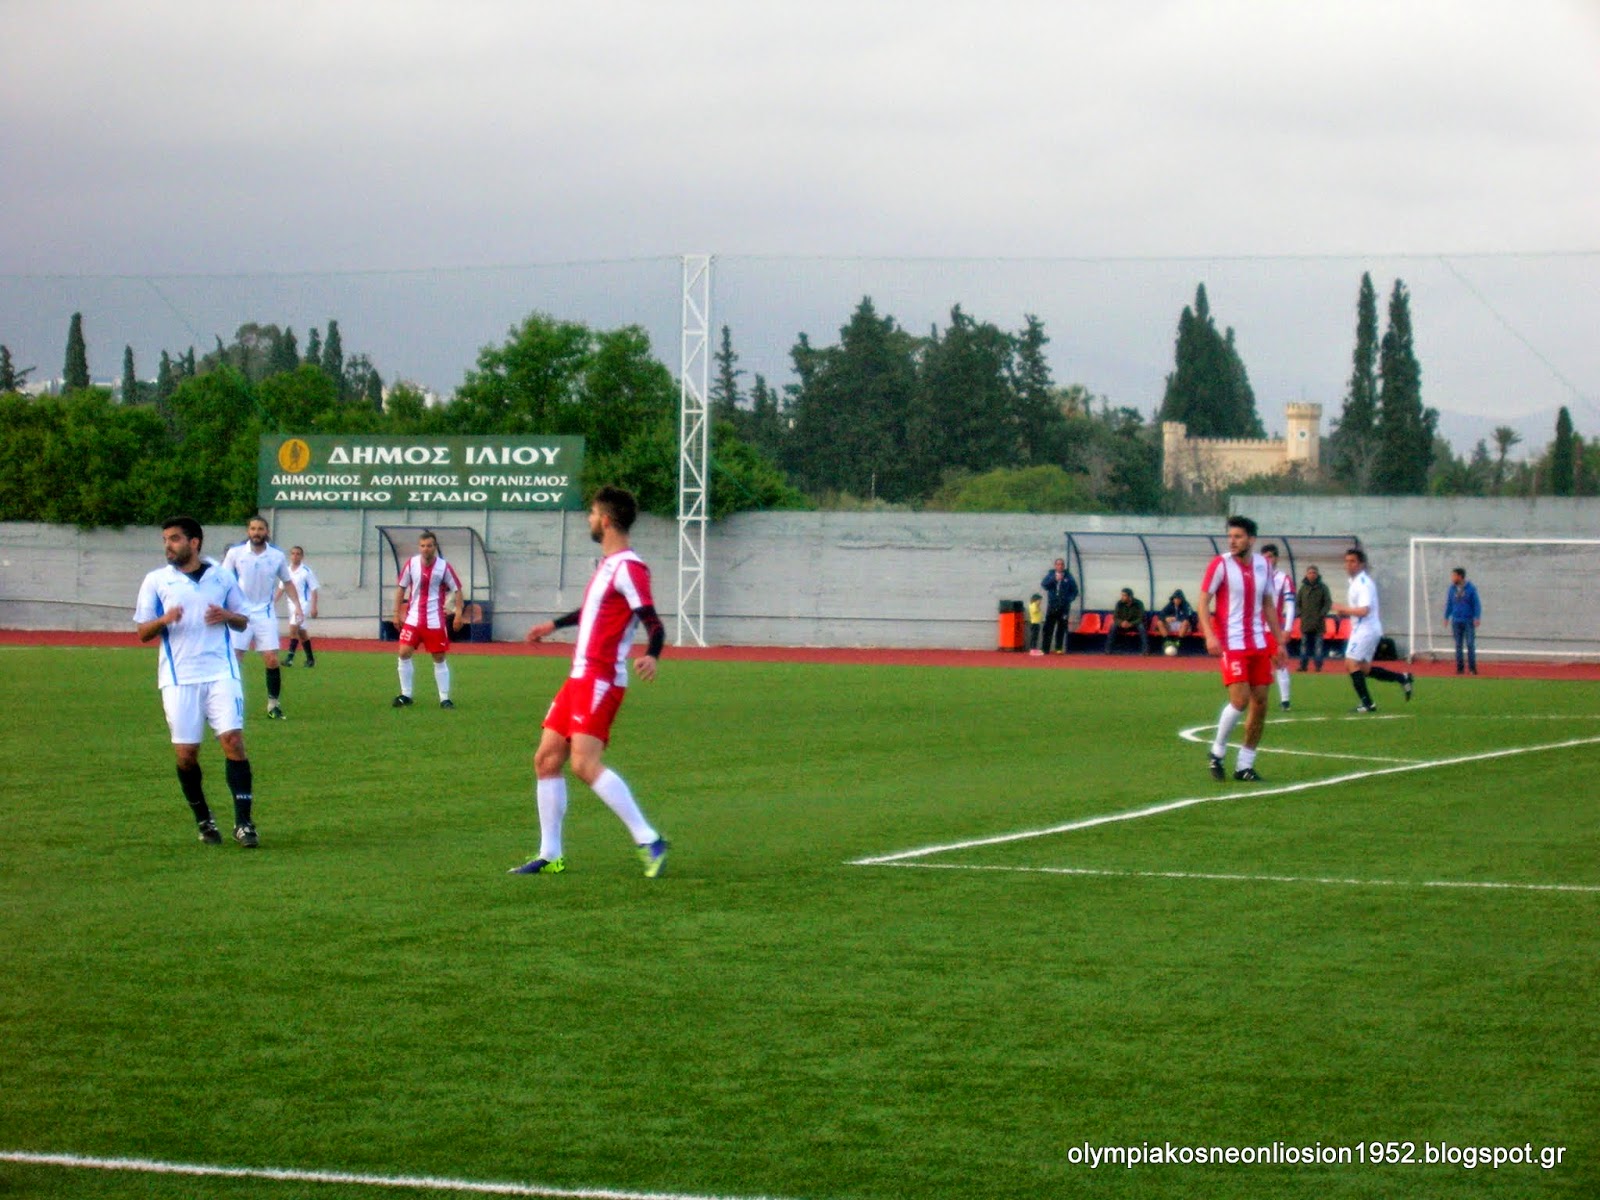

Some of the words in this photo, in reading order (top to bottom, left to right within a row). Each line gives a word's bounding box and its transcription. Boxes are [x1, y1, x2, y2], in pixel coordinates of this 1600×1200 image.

[328, 447, 450, 465] ΔΗΜΟΣ
[465, 447, 561, 465] ΙΛΙΟΥ
[271, 474, 361, 486] ΔΗΜΟΤΙΚΟΣ
[370, 474, 459, 486] ΑΘΛΗΤΙΚΟΣ
[468, 475, 569, 487] ΟΡΓΑΝΙΣΜΟΣ
[274, 491, 392, 502] ΔΗΜΟΤΙΚΟ
[407, 491, 488, 503] ΣΤΑΔΙΟ
[501, 492, 563, 503] ΙΛΙΟΥ
[1230, 661, 1243, 676] 5
